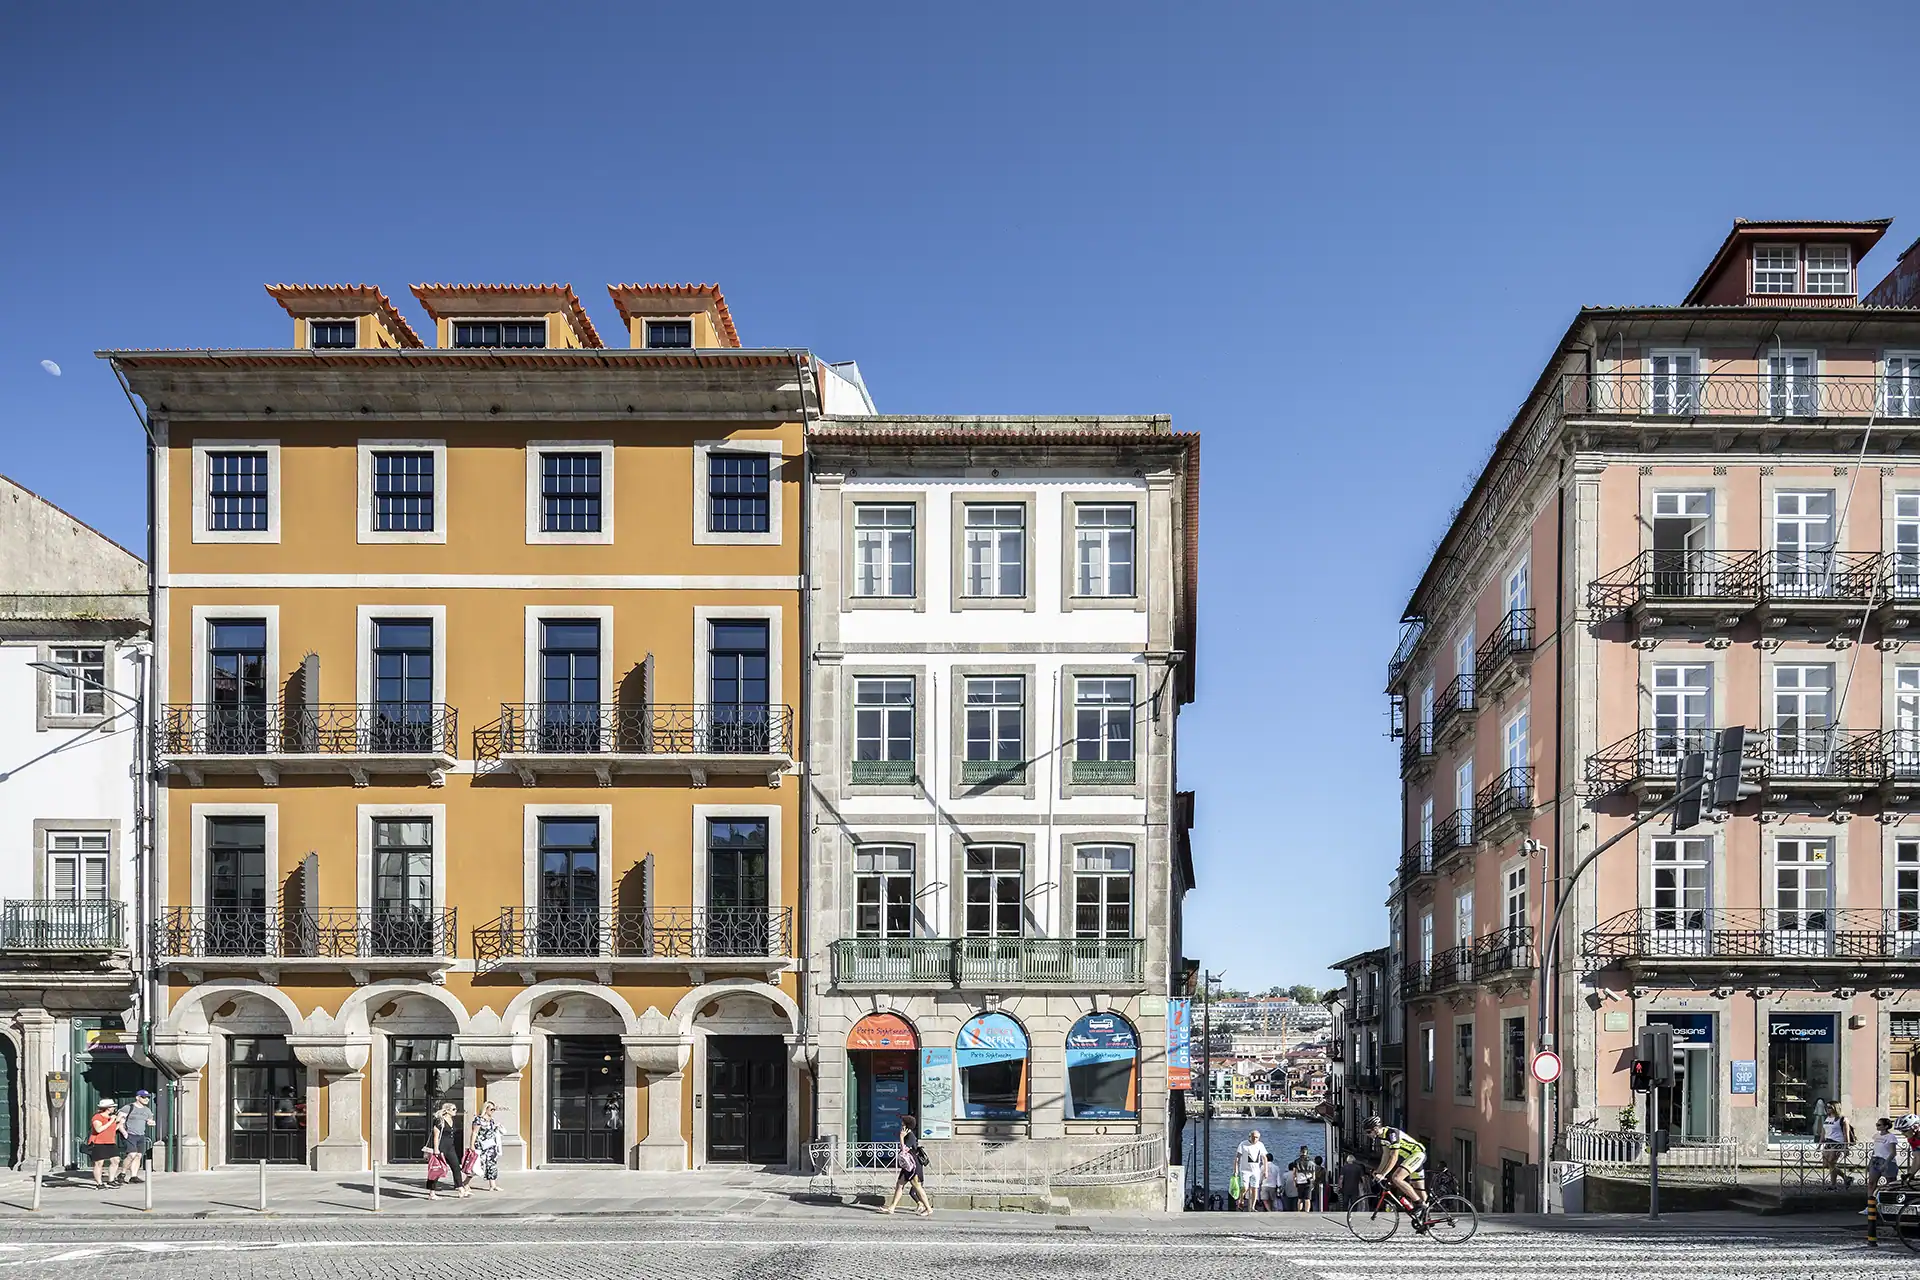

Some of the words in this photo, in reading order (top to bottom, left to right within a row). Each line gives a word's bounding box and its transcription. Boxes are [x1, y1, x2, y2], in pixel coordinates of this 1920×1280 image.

[856, 1026, 874, 1035] Porto
[985, 1027, 1013, 1035] TICKET
[985, 1036, 1015, 1044] OFFICE
[1170, 1028, 1178, 1064] TICKET
[1180, 1026, 1188, 1064] OFFICE
[1736, 1072, 1752, 1082] SHOP
